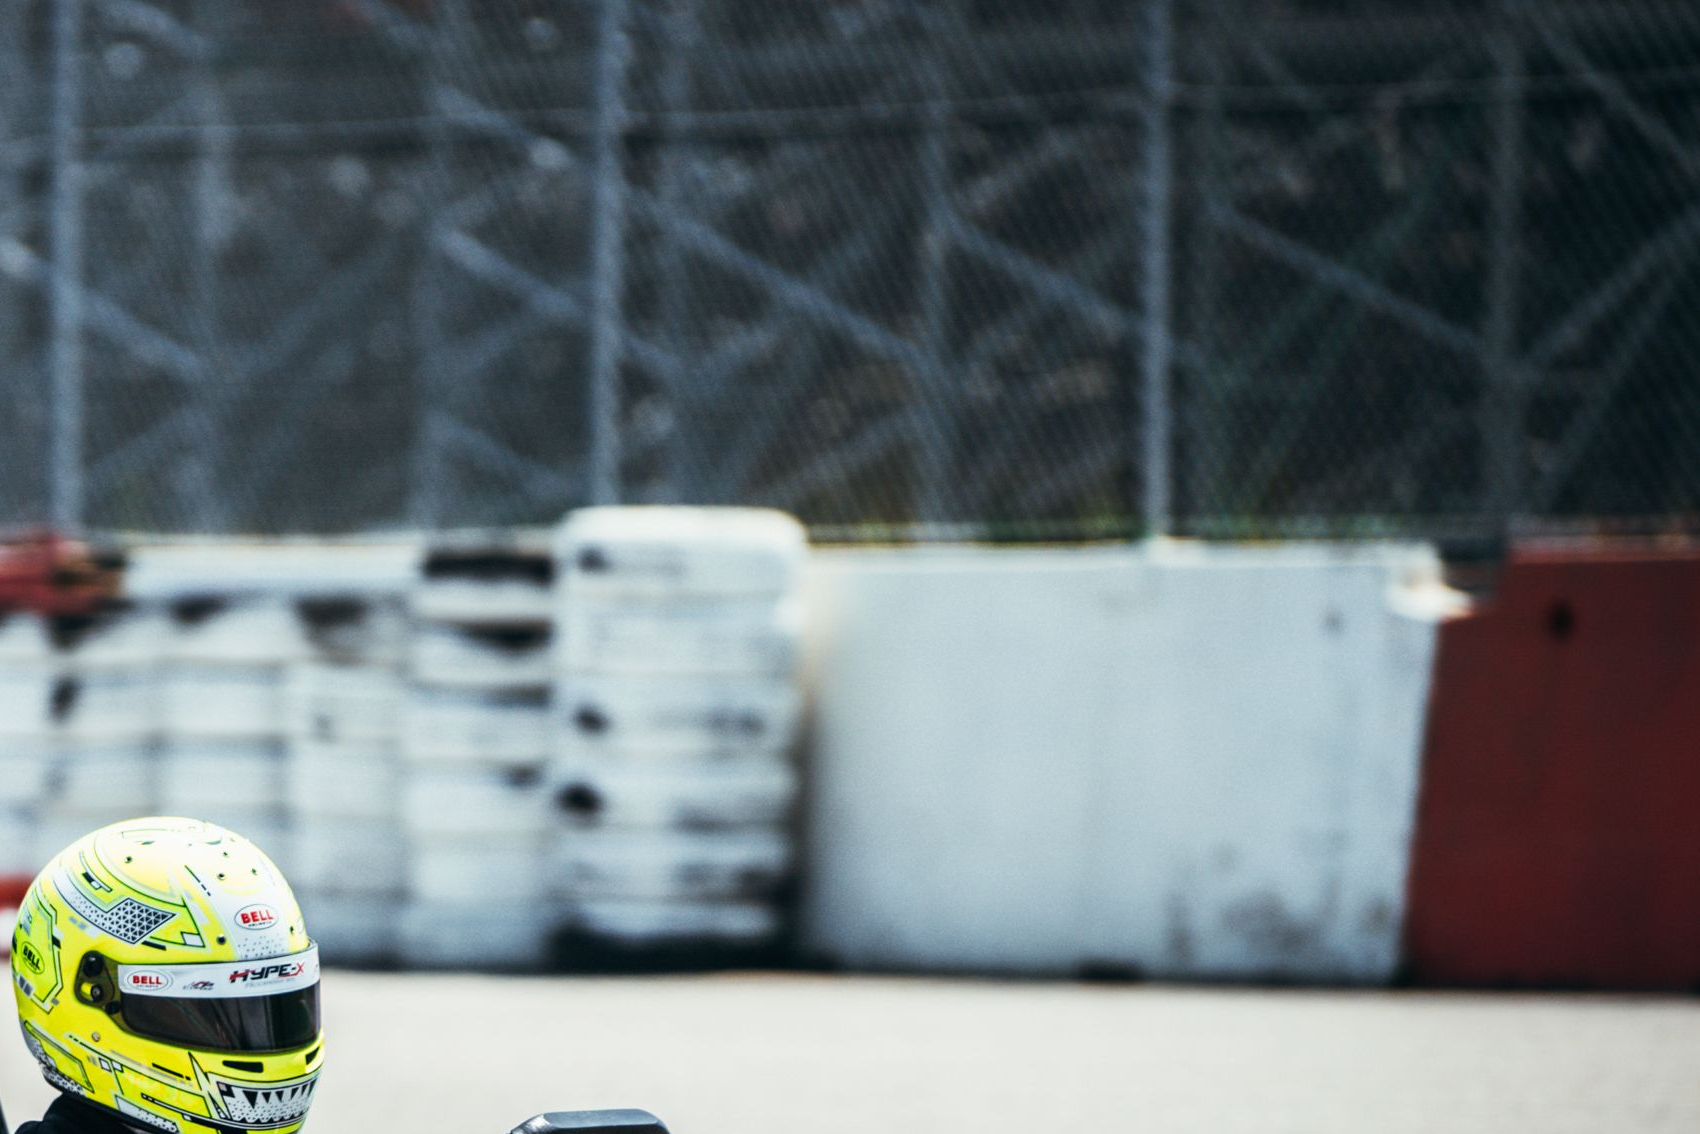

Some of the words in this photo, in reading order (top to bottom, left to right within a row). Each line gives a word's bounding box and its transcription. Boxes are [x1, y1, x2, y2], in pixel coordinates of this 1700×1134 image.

[241, 909, 274, 924] BELL
[23, 945, 41, 970] BELL
[132, 975, 163, 985] BELL
[228, 961, 305, 985] HYPE-X
